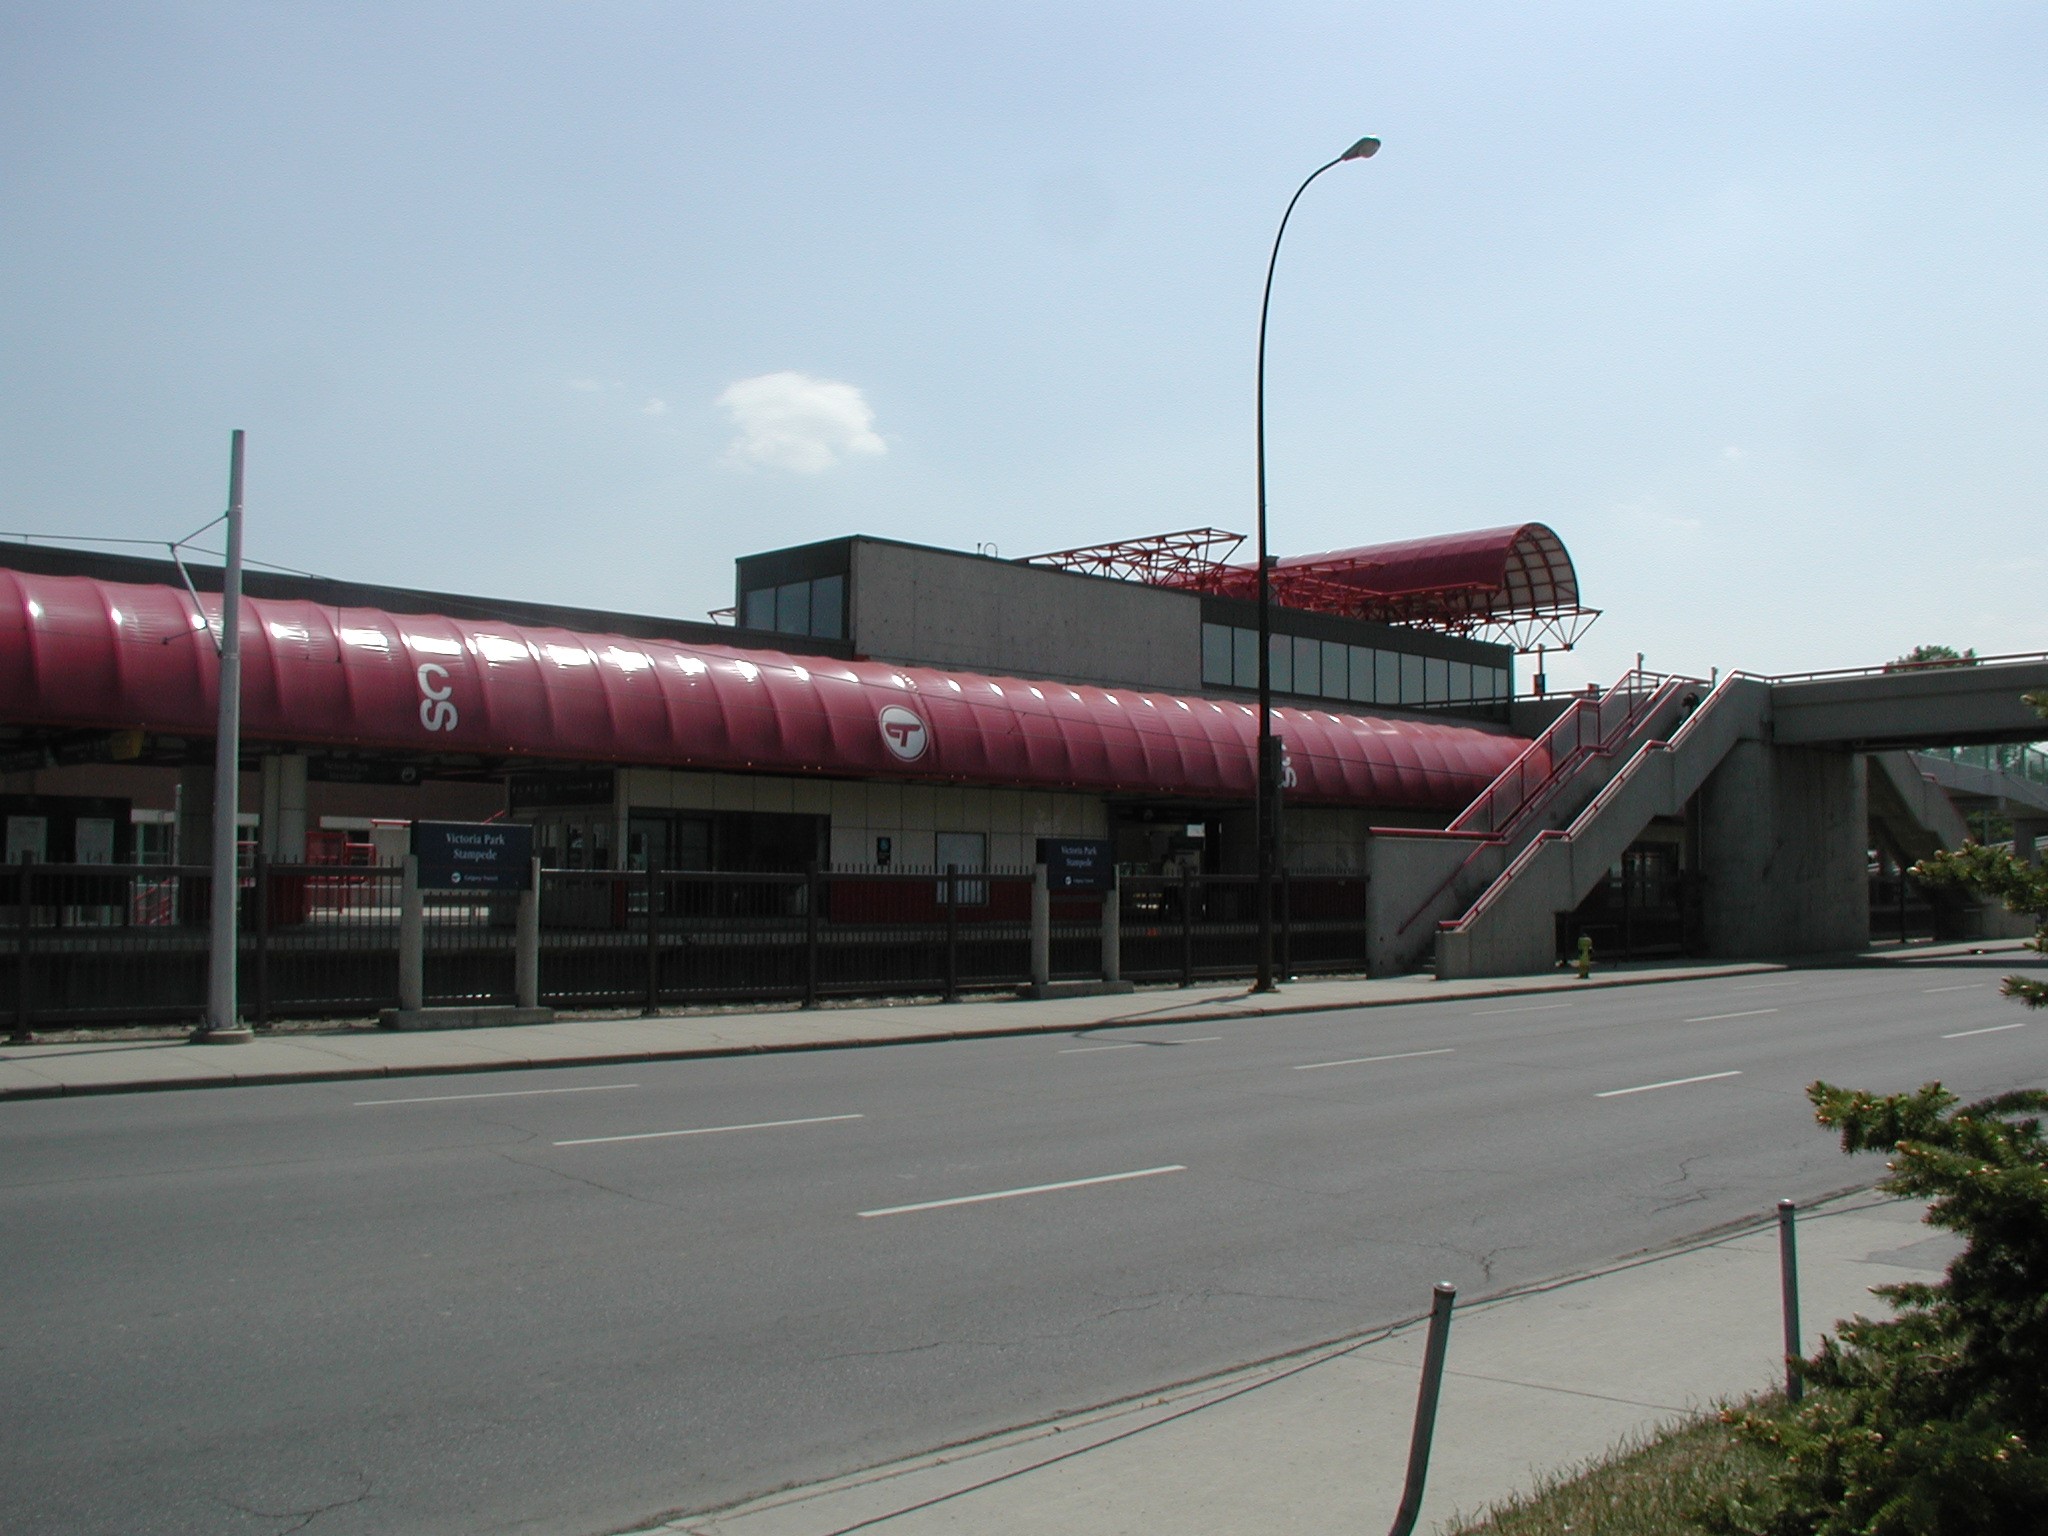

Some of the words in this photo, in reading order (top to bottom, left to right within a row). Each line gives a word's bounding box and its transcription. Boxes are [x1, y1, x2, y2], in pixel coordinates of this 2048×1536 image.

[446, 832, 482, 845] Victoria
[484, 833, 506, 846] Park
[453, 848, 498, 863] Stampede
